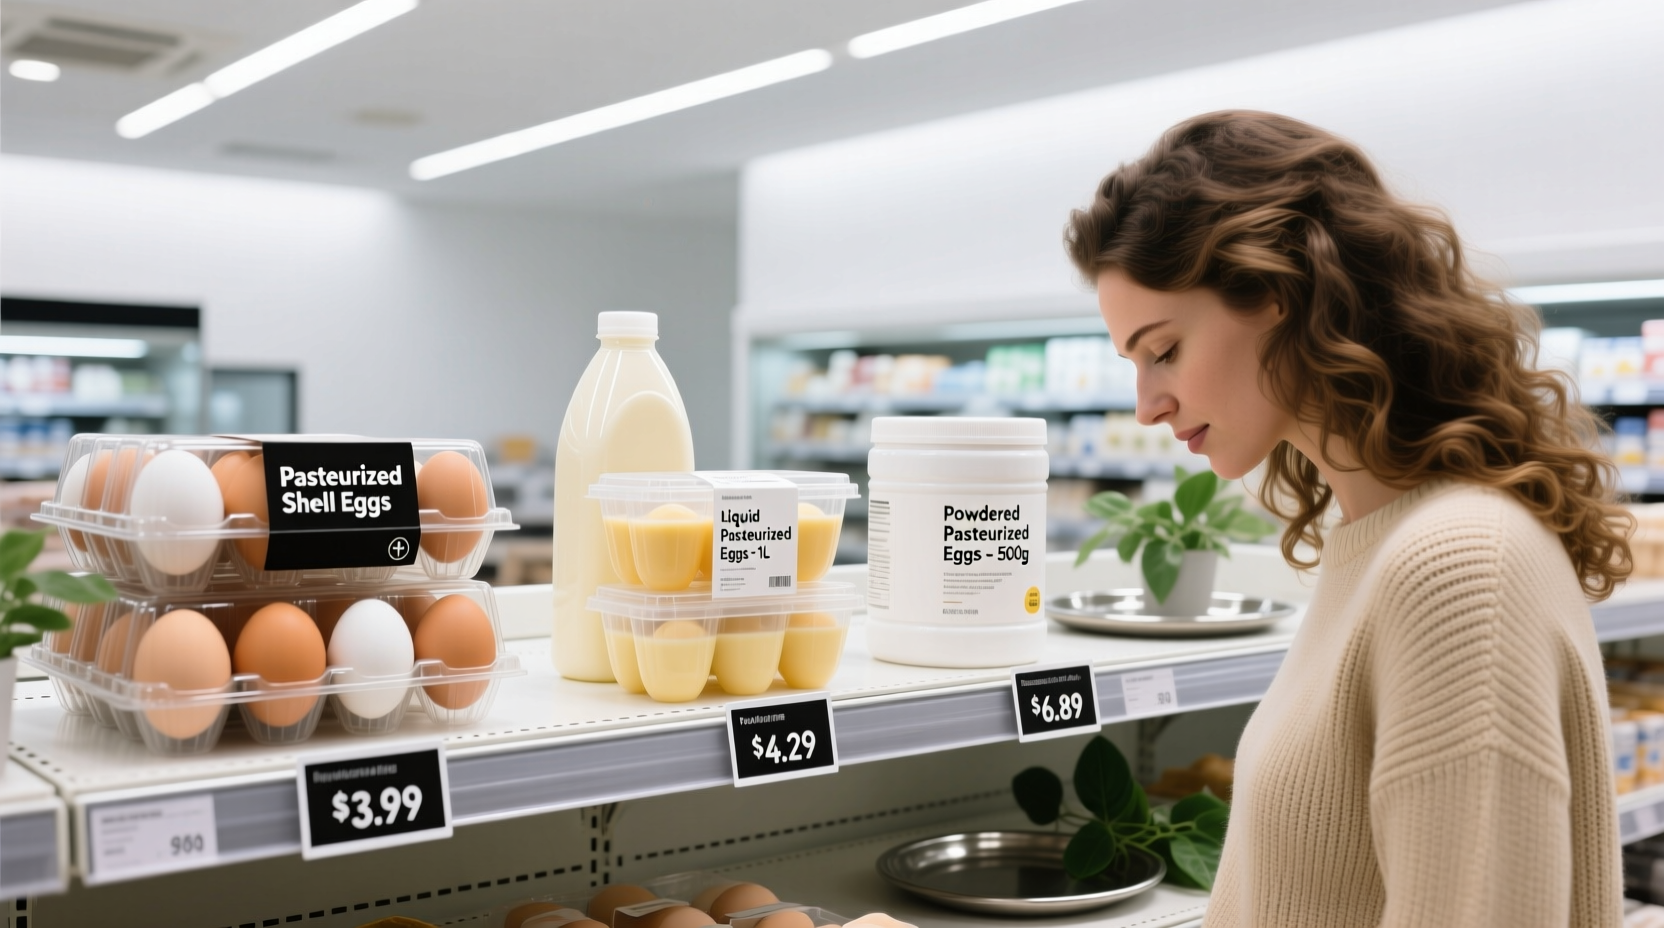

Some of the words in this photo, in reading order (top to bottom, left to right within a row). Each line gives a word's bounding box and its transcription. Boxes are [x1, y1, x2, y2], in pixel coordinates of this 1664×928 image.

[279, 463, 403, 488] Pasteurized
[282, 491, 336, 514] Shell
[341, 491, 392, 519] Eggs
[943, 504, 1020, 522] Powdered
[720, 508, 760, 528] Liquid
[720, 525, 792, 543] Pasteurized
[943, 524, 1030, 542] Pasteurized
[720, 546, 749, 563] Eggs
[757, 545, 771, 560] 1L
[943, 545, 982, 565] Eggs
[997, 545, 1030, 566] 500g
[1030, 692, 1083, 723] $6.89
[751, 729, 816, 764] $4.29
[331, 784, 423, 830] $3.99
